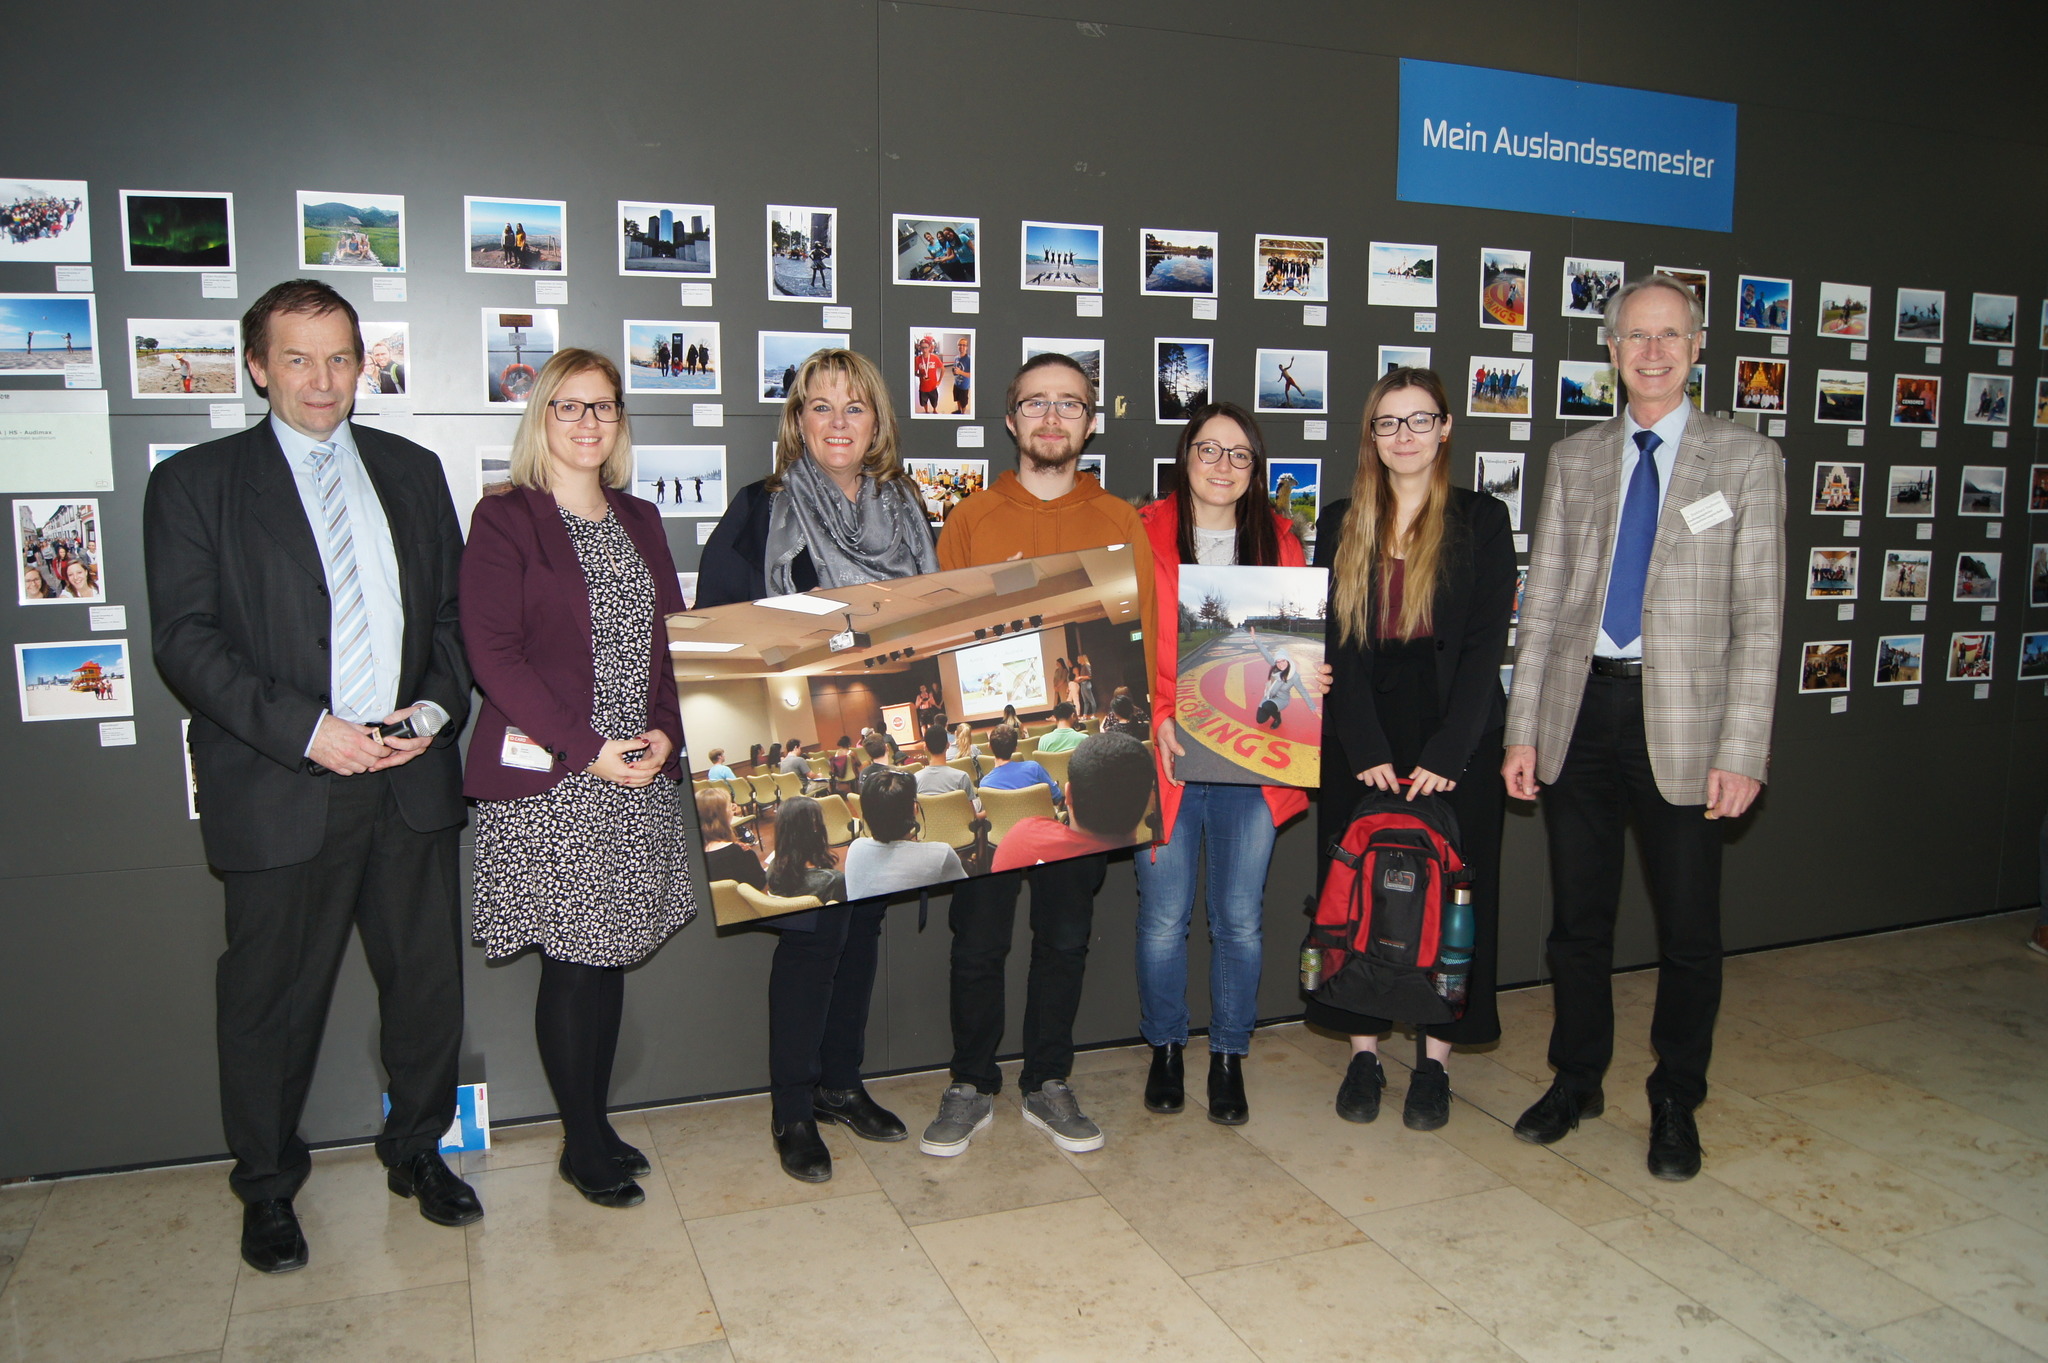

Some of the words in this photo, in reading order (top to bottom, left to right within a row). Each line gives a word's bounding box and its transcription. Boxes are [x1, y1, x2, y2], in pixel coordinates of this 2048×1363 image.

[1422, 117, 1487, 153] Mein
[1492, 126, 1715, 179] Auslandssemester
[1176, 678, 1292, 769] LINKÖPINGS
